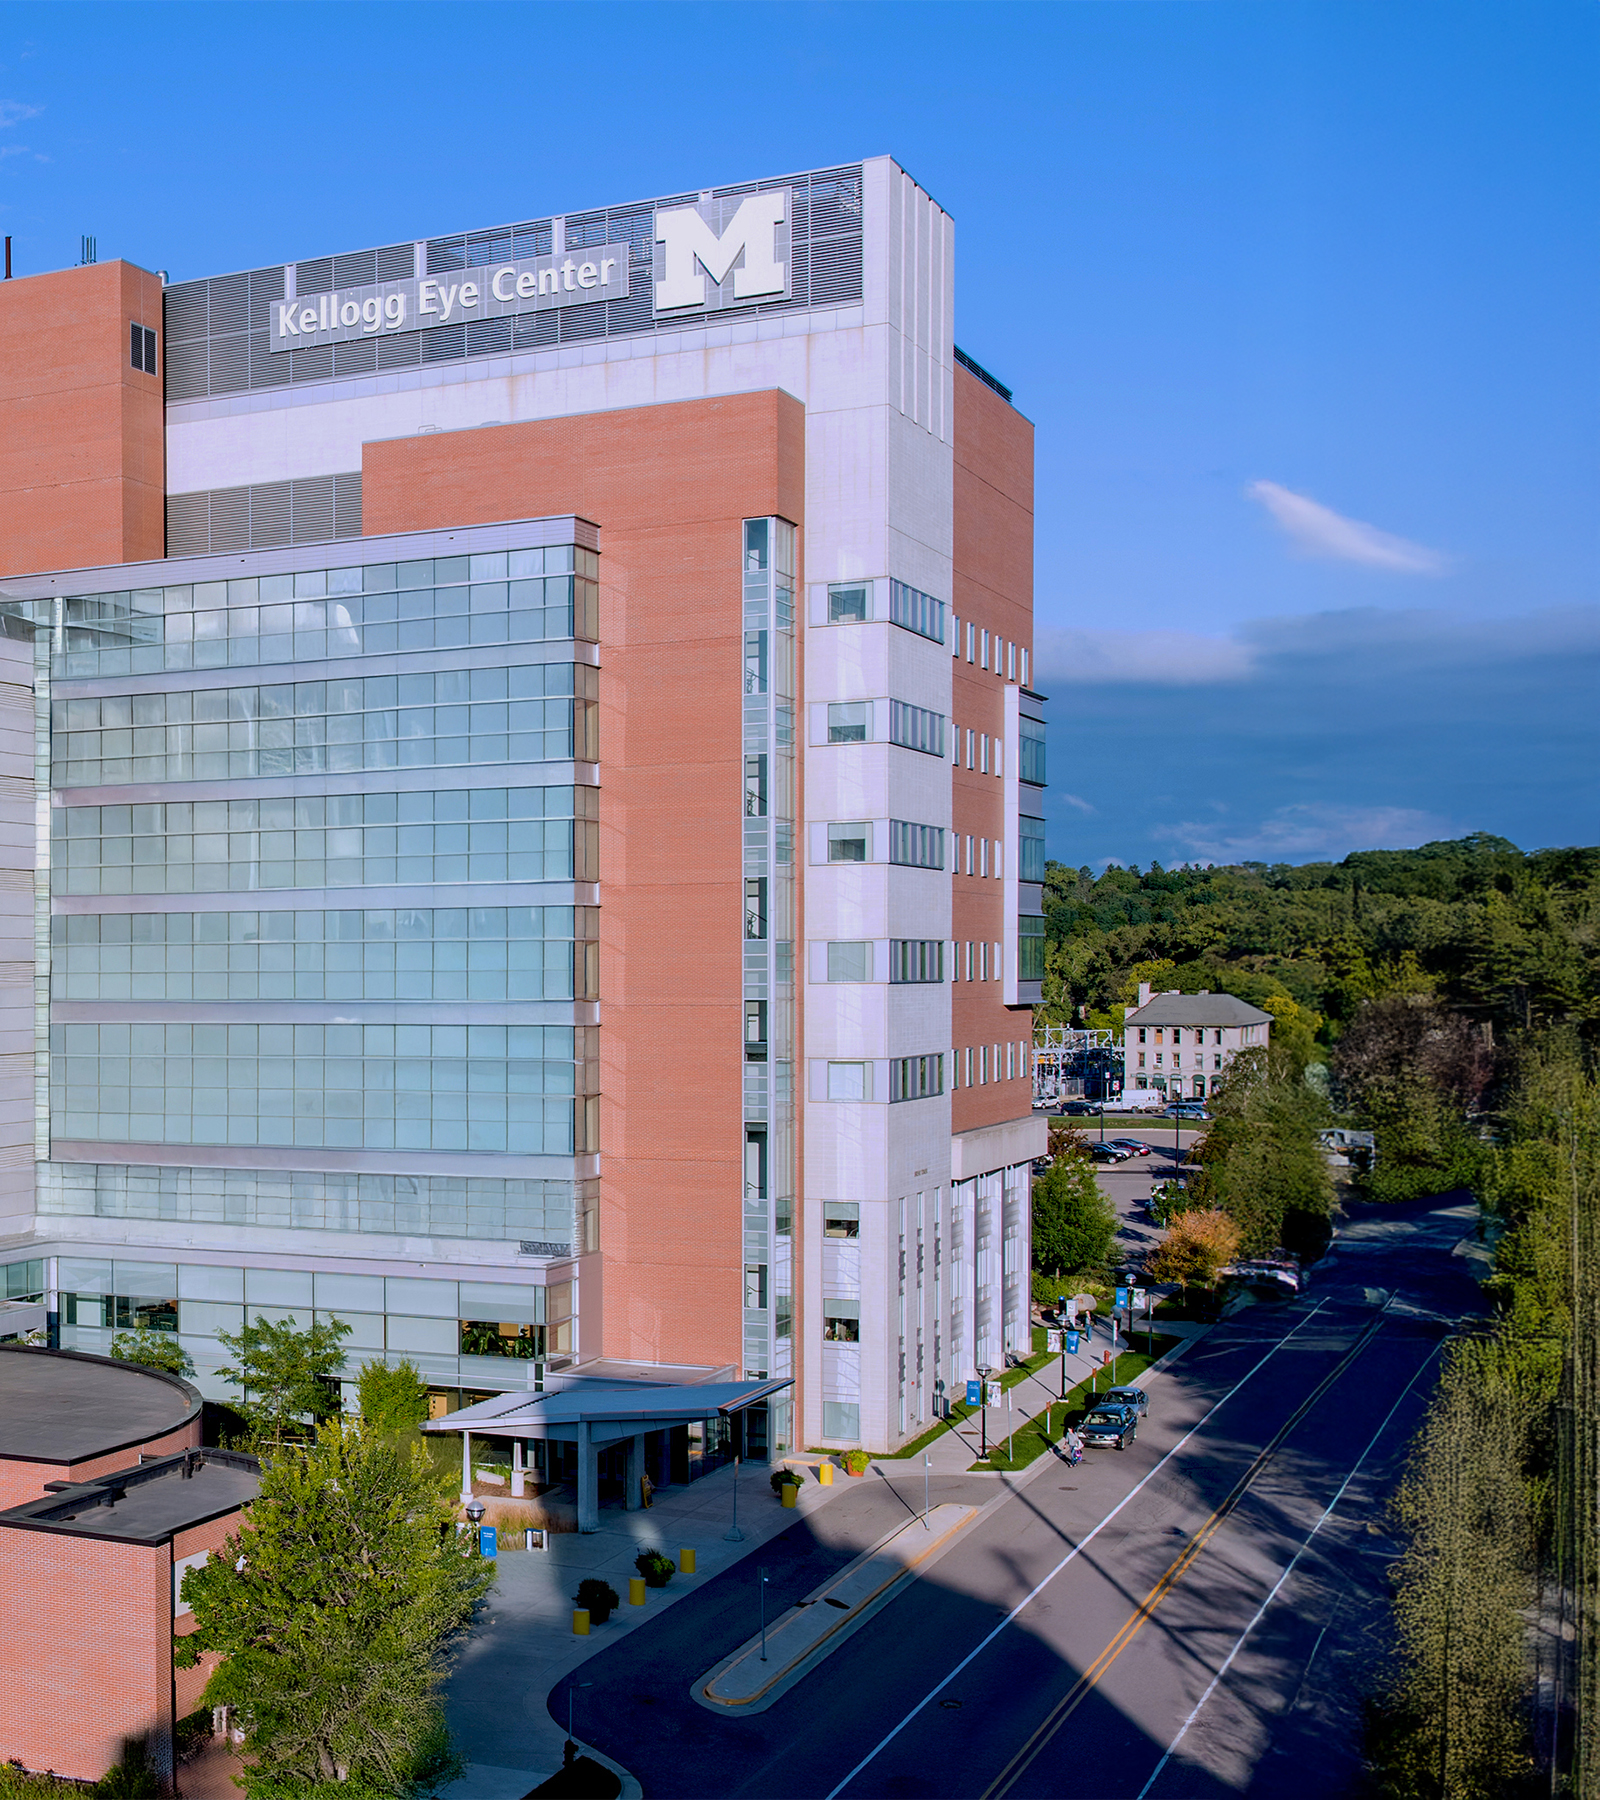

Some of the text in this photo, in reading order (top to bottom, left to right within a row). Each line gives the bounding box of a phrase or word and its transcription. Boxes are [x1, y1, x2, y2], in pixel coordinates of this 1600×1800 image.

[279, 257, 615, 337] Kellogg Eye Center
[656, 192, 784, 311] M
